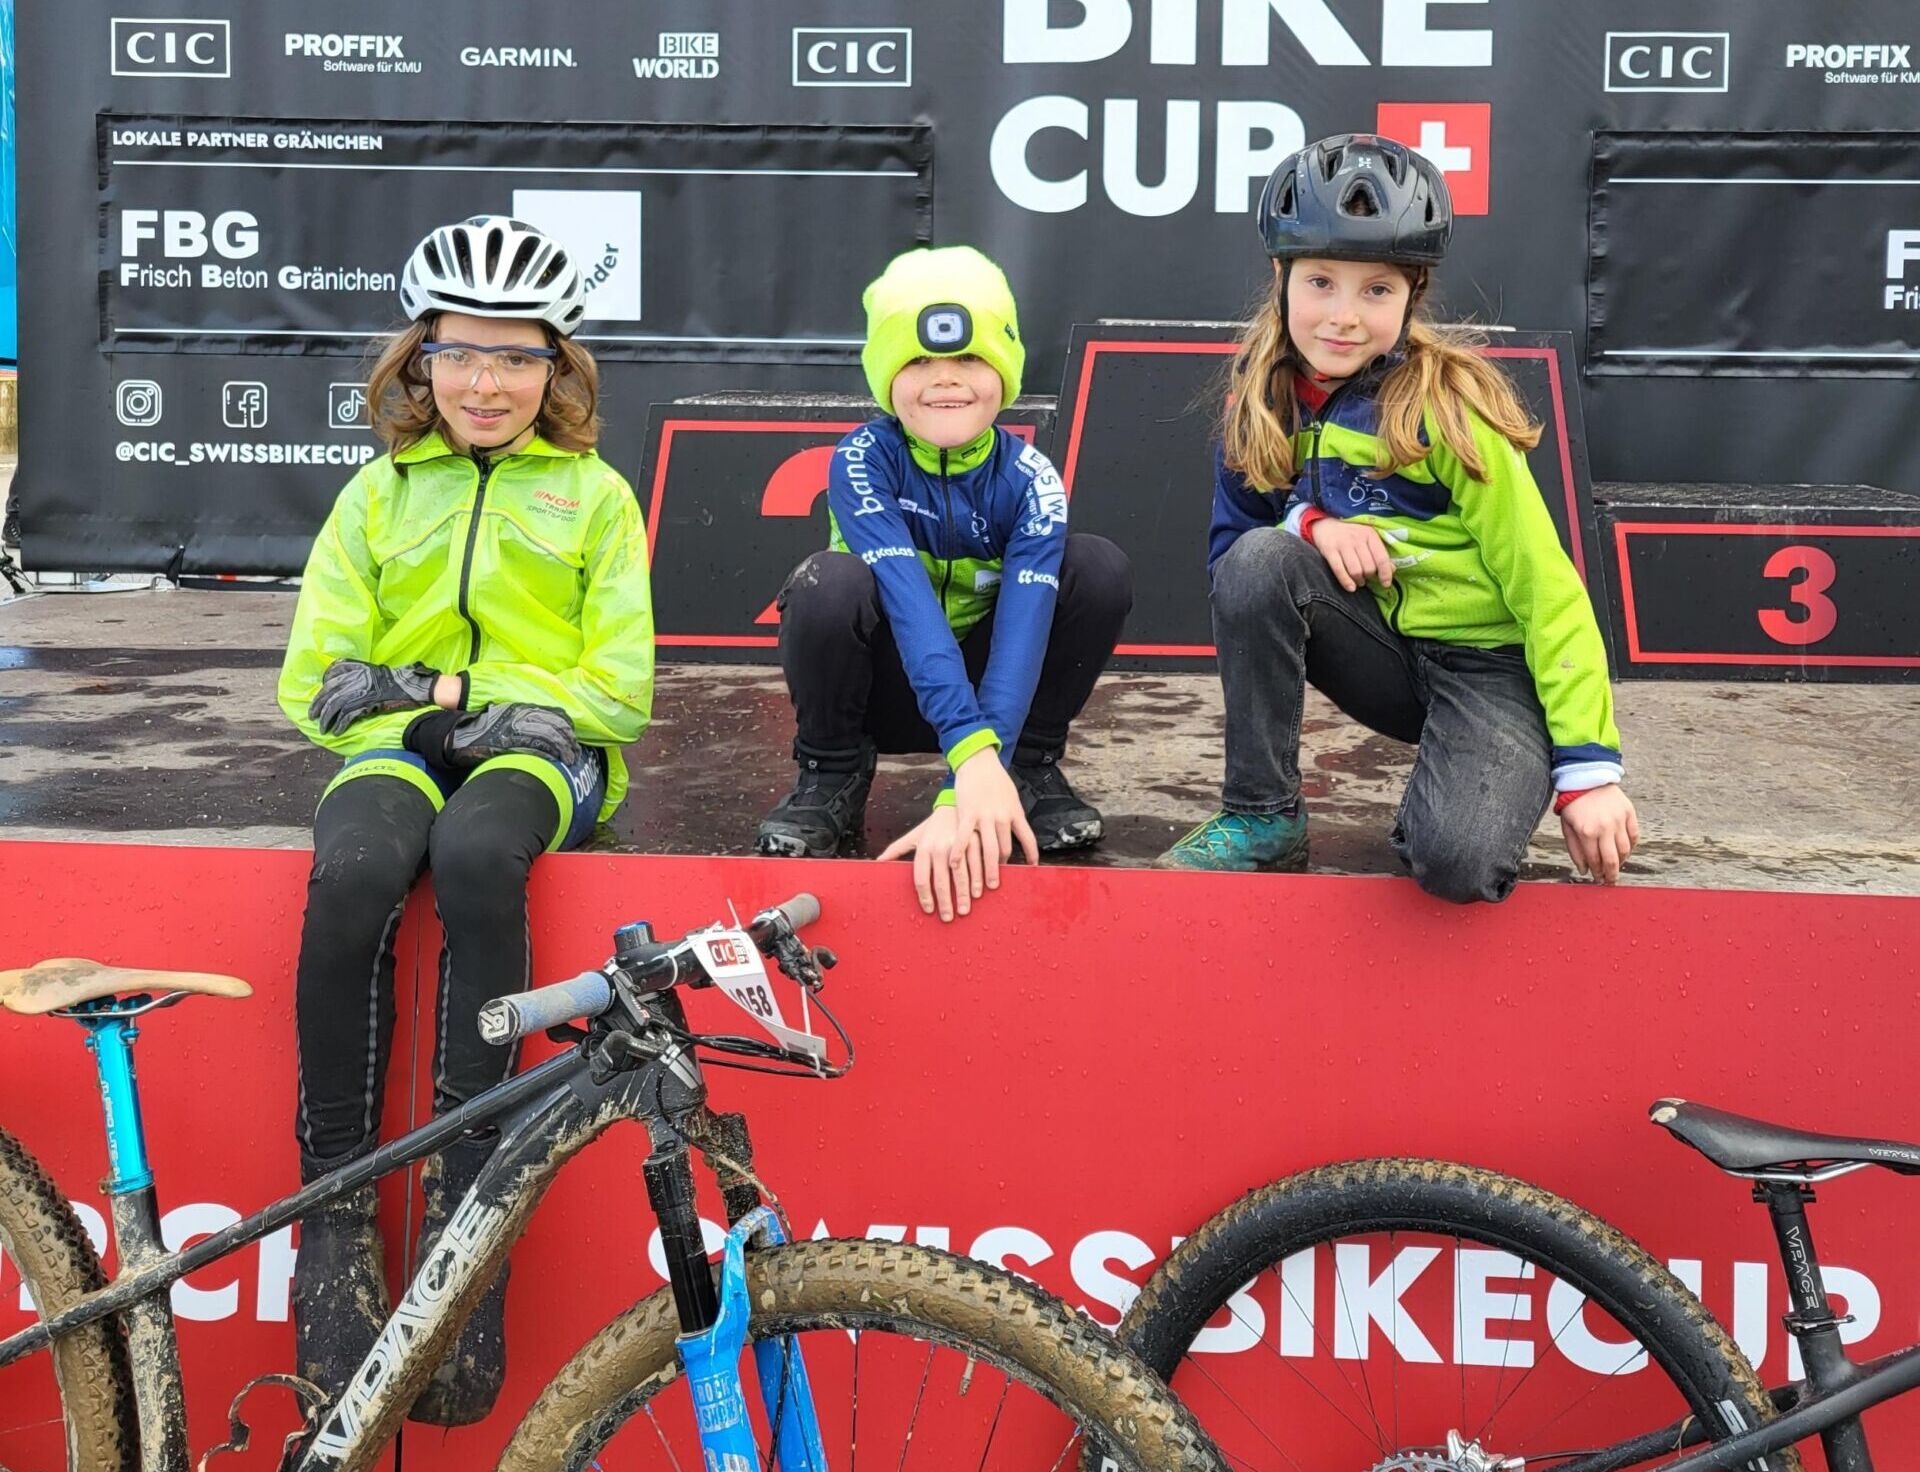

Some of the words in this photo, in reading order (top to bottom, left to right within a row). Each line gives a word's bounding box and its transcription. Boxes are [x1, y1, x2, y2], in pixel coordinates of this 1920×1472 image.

[285, 33, 404, 58] PROFFIX
[662, 34, 717, 56] BIKE
[1003, 0, 1494, 66] BIKE
[126, 31, 215, 64] CIC
[806, 41, 897, 74] CIC
[1786, 44, 1911, 68] PROFFIX
[323, 59, 375, 73] Software
[377, 60, 393, 73] für
[394, 61, 422, 73] KMU
[632, 57, 719, 79] WORLD
[1618, 45, 1713, 79] CIC
[1824, 71, 1879, 84] Software
[1881, 71, 1898, 84] für
[112, 131, 181, 147] LOKALE
[187, 132, 269, 149] PARTNER
[273, 130, 383, 151] GRÄNICHEN
[989, 95, 1306, 217] CUP
[121, 209, 259, 260] FBG
[120, 263, 191, 288] Frisch
[201, 264, 268, 289] Beton
[277, 265, 396, 292] Gränichen
[1884, 284, 1920, 310] Fri
[115, 441, 375, 466] @CIC_SWISSBIKECUP
[1758, 545, 1838, 645] 3
[711, 942, 737, 964] CIC
[648, 1218, 1882, 1382] SIKECUP
